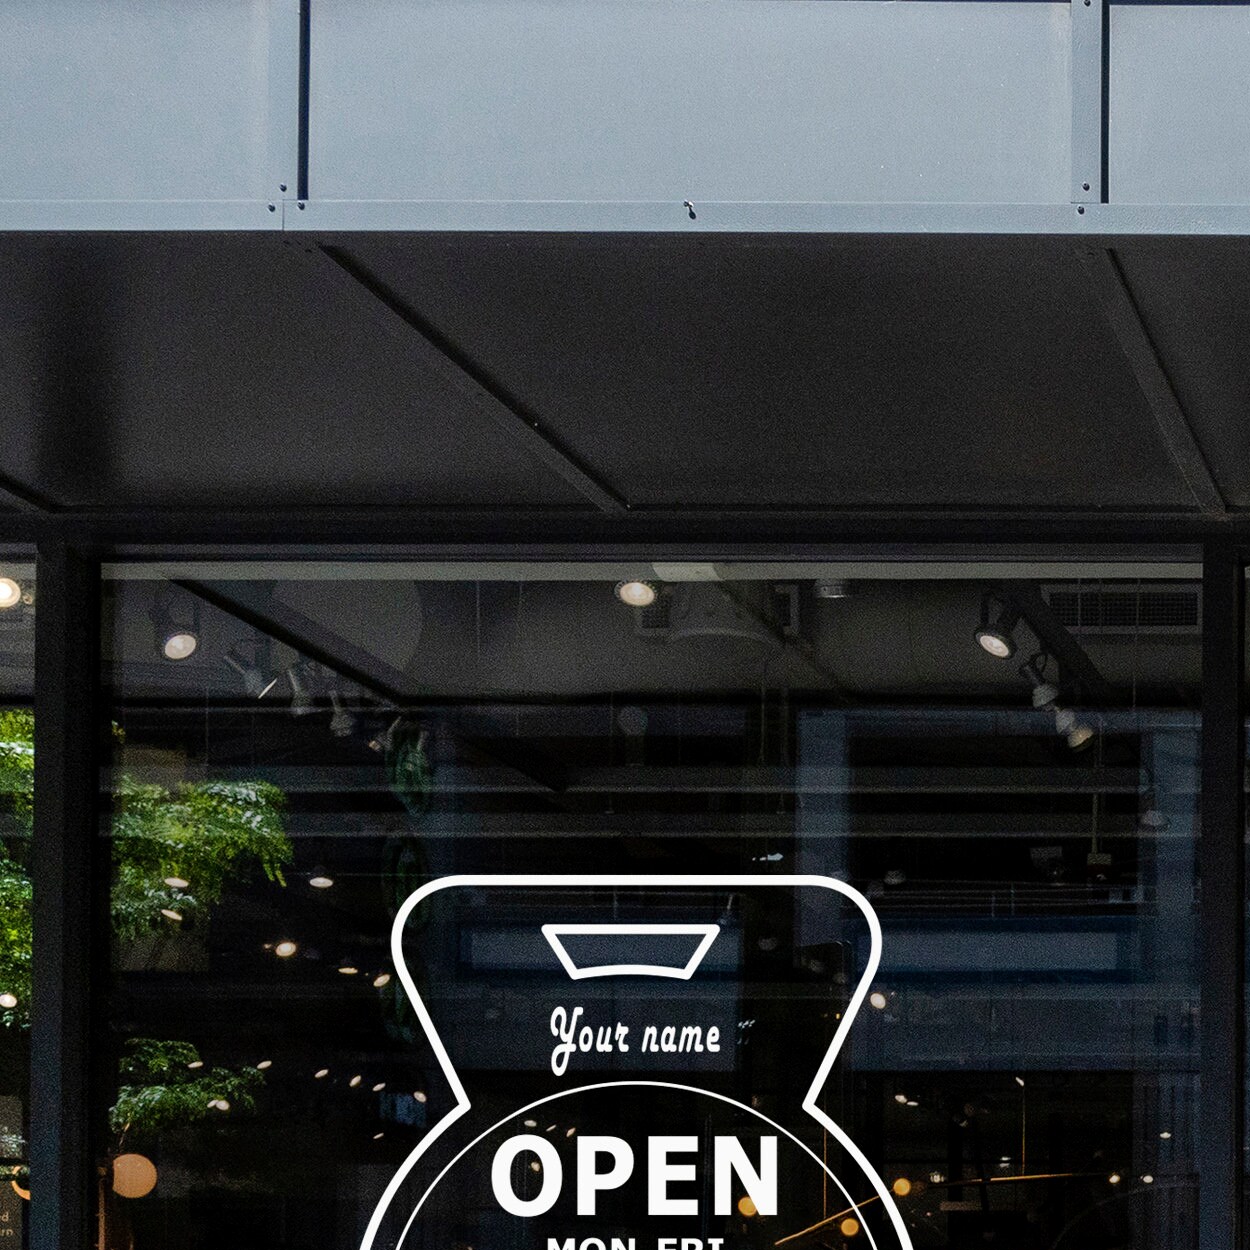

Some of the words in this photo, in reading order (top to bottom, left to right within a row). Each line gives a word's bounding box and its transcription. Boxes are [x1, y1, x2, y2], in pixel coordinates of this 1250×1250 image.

[550, 1006, 629, 1077] Your
[641, 1025, 721, 1053] name
[491, 1134, 778, 1218] OPEN
